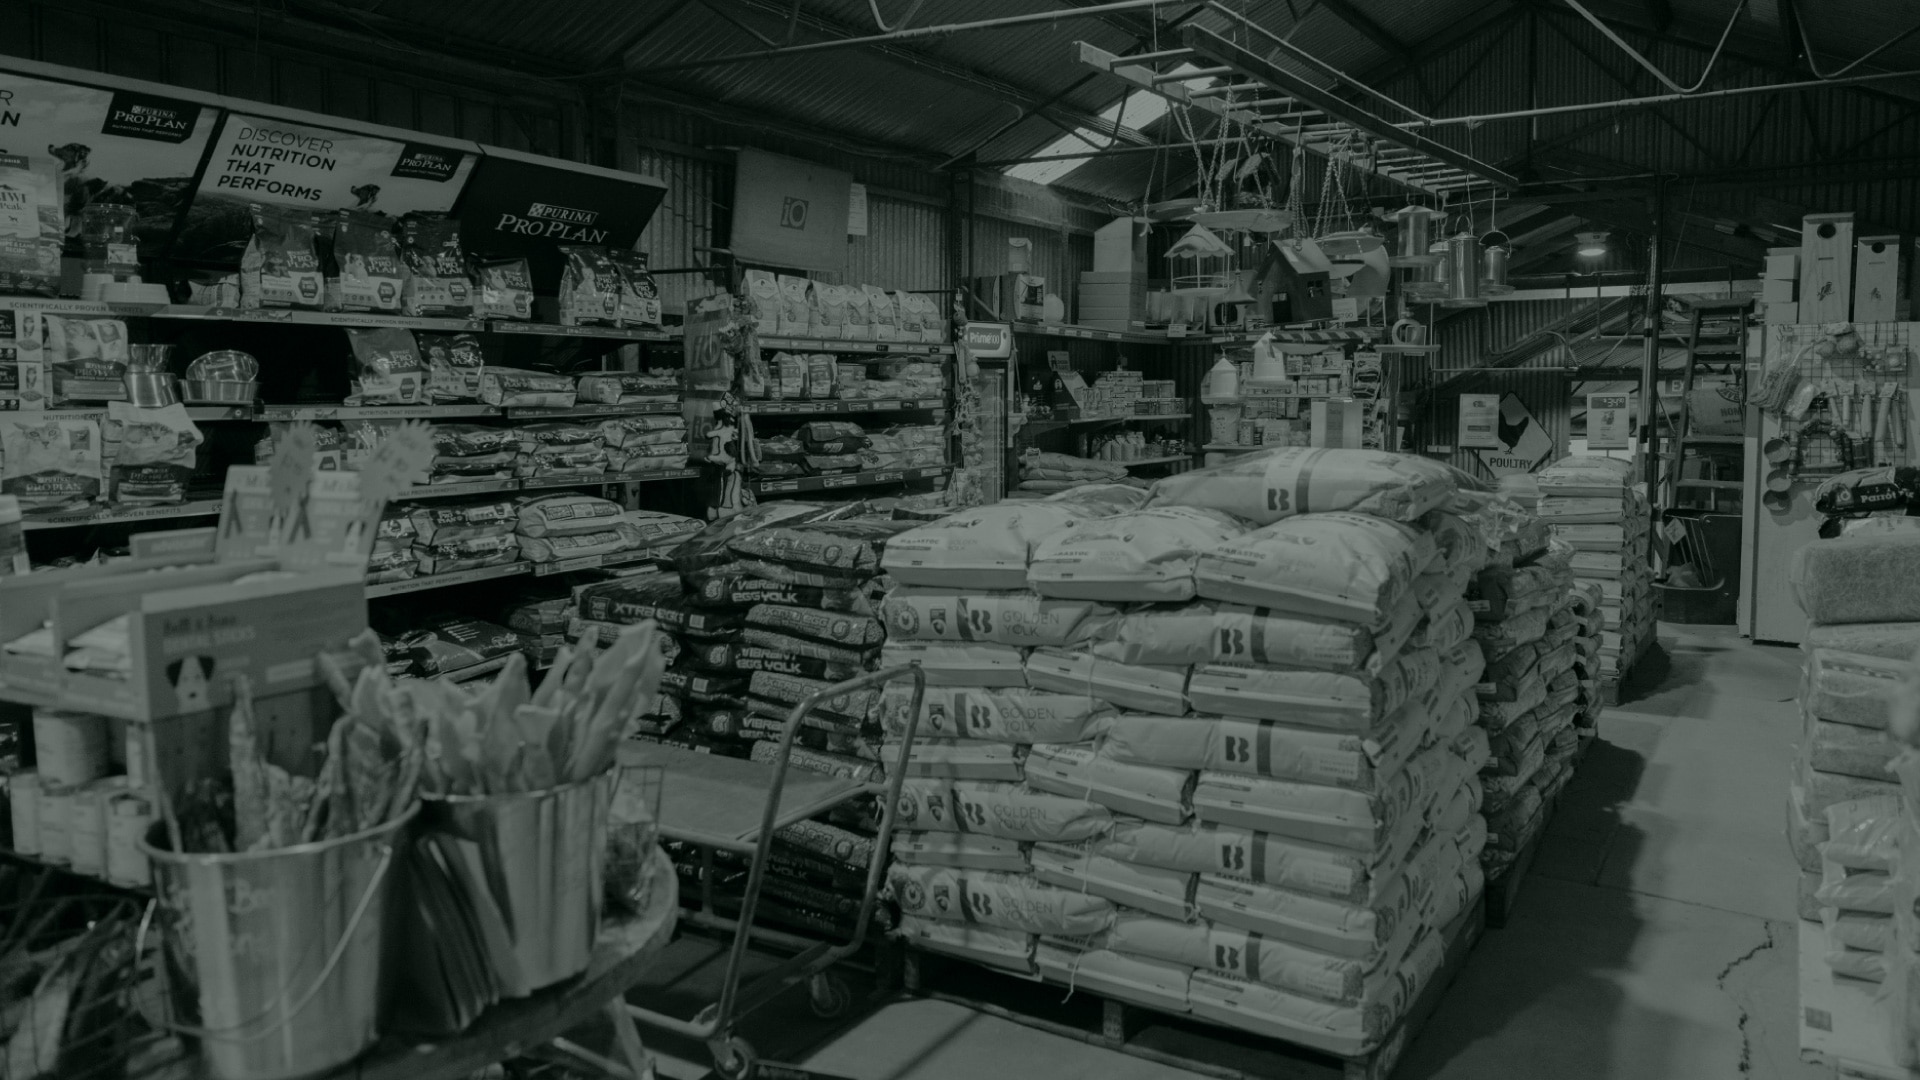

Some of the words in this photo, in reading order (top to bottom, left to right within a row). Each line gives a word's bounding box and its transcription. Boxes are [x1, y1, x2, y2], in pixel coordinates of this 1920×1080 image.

[114, 110, 145, 124] PRO
[146, 114, 187, 130] PLAN
[140, 107, 175, 119] PURINA
[238, 127, 334, 154] DISCOVER
[231, 143, 337, 171] NUTRITION
[226, 159, 275, 175] THAT
[400, 158, 422, 167] PRO
[422, 160, 452, 171] PLAN
[217, 175, 323, 201] PERFORMS
[543, 207, 592, 223] PURINA
[494, 213, 545, 236] PRO
[544, 220, 611, 244] PLAN
[288, 254, 313, 263] PRO
[9, 302, 74, 311] SCIENTIFICALLY
[75, 304, 107, 312] PROVEN
[390, 360, 419, 368] PLAN
[391, 353, 413, 362] PRO
[1490, 457, 1533, 469] POULTRY
[1860, 492, 1897, 504] Parrot
[47, 513, 111, 524] SCIENTIFICALLY
[146, 507, 182, 516] BENEFITS
[760, 590, 798, 604] YOLK
[1002, 611, 1060, 625] GOLDEN
[1004, 624, 1041, 637] YOLK
[763, 660, 801, 675] YOLK
[1000, 707, 1057, 720] GOLDEN
[1004, 721, 1038, 733] YOLK
[767, 731, 803, 746] YOK
[993, 804, 1048, 819] GOLDEN
[1002, 896, 1053, 914] GOLDEN
